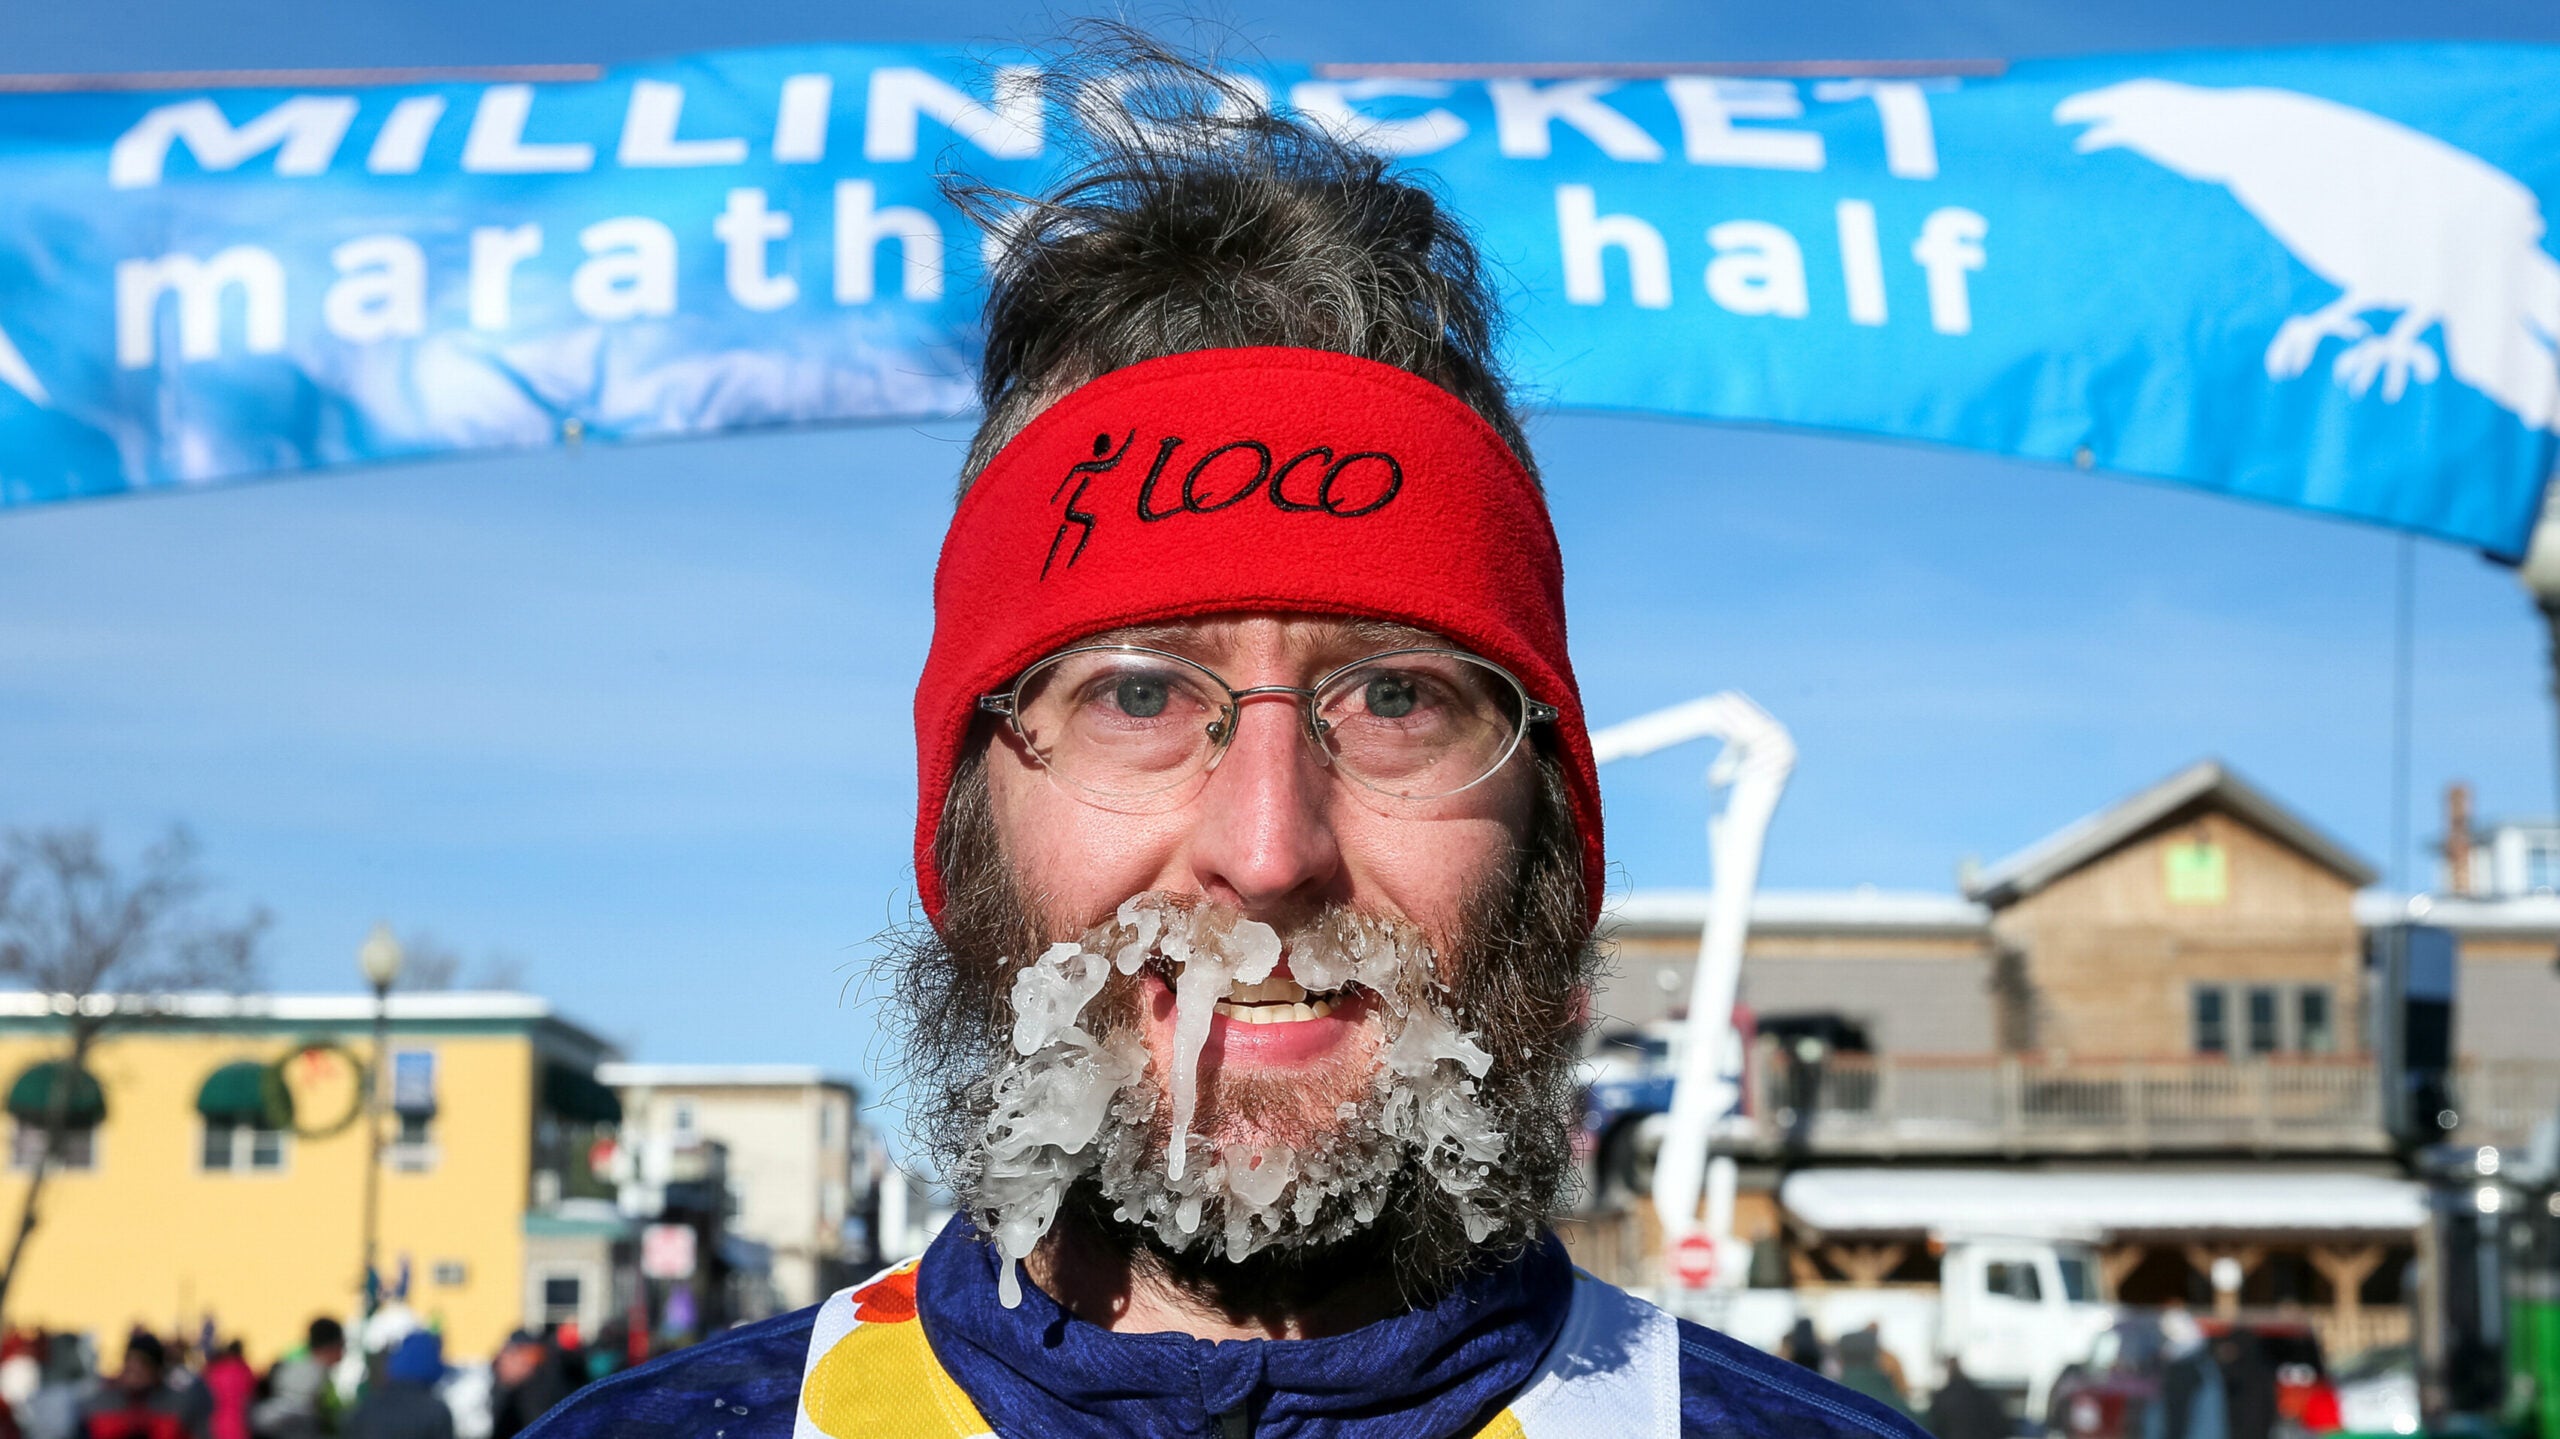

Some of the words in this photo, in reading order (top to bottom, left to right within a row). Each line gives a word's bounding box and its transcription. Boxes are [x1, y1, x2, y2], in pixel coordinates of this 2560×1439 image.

[115, 180, 1085, 367] marath
[1555, 183, 1989, 335] half
[1137, 437, 1403, 522] LOCO
